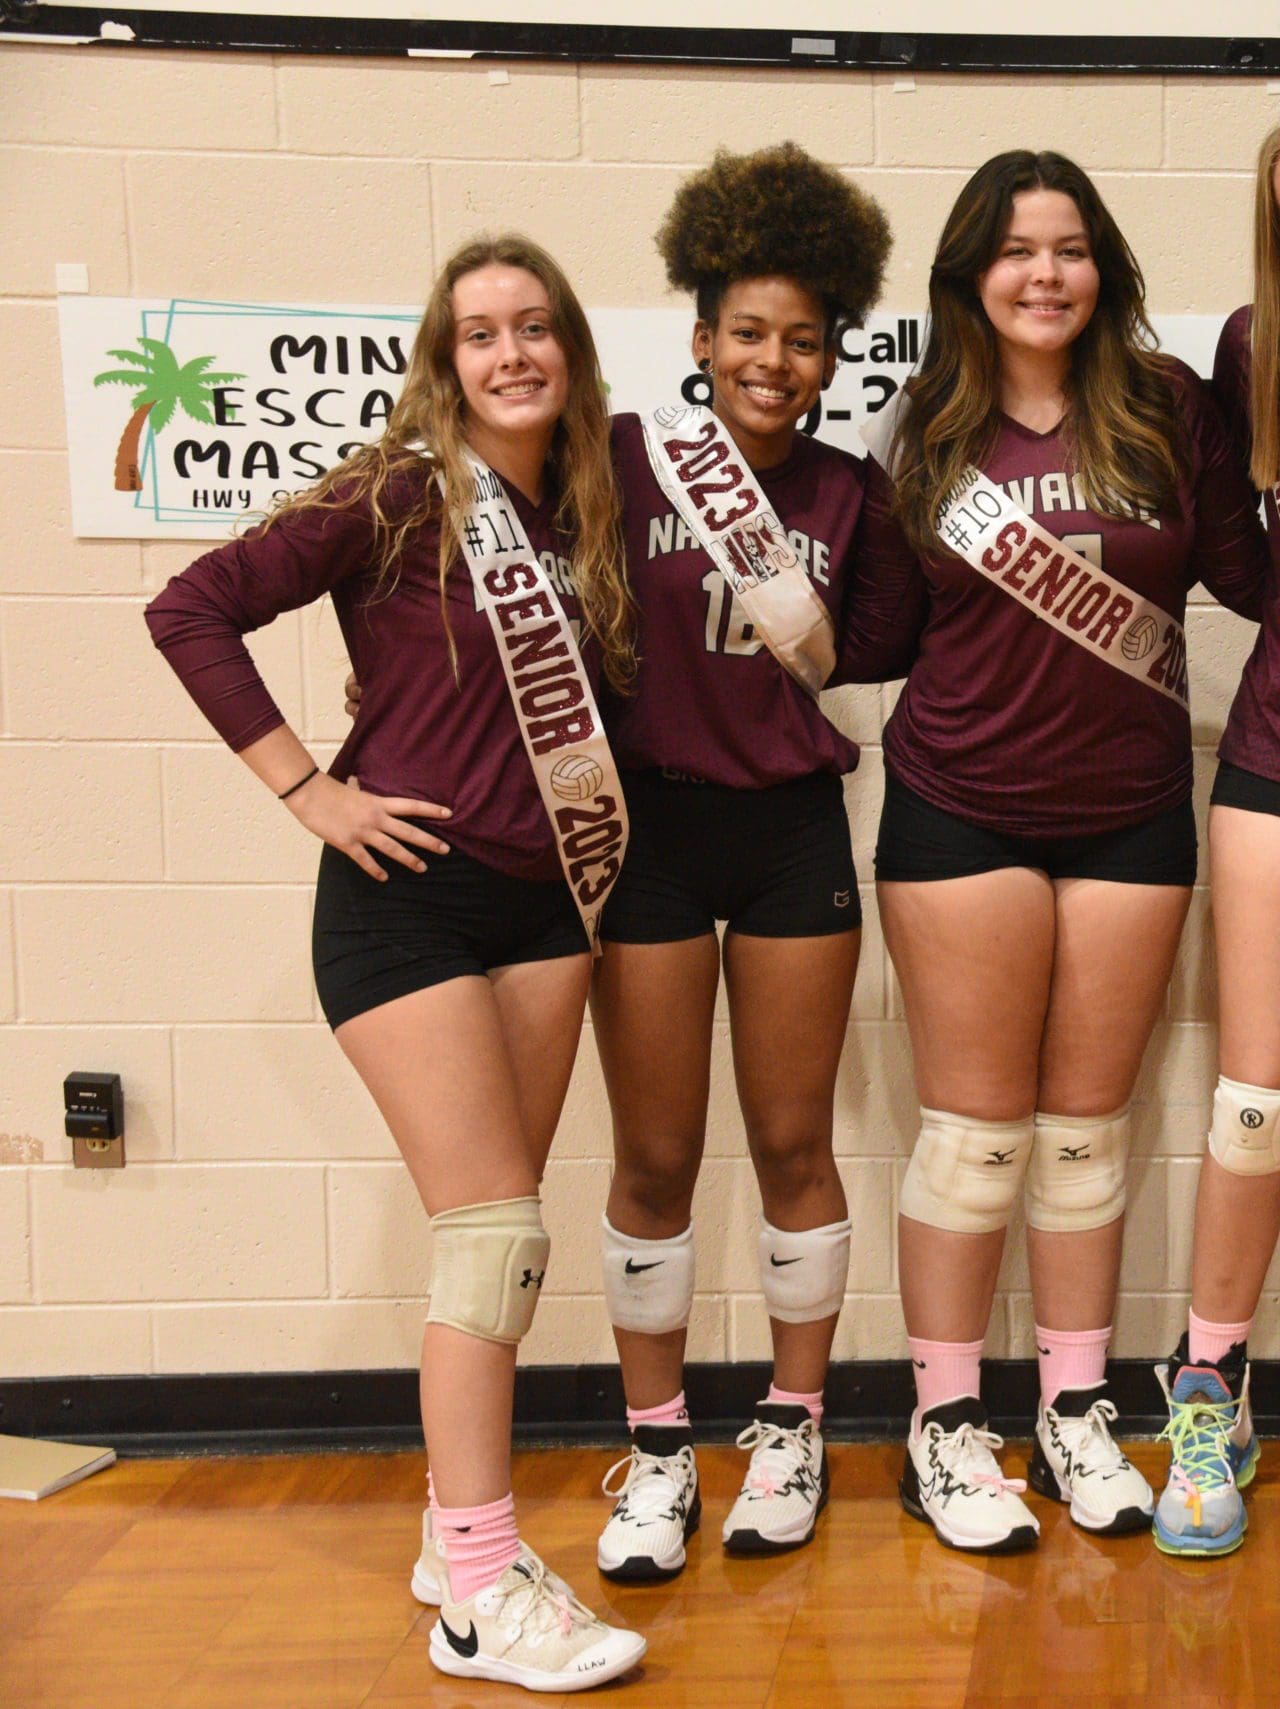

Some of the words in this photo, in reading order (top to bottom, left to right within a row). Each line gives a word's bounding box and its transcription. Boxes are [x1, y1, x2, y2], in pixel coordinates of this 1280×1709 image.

[838, 319, 919, 363] Call
[663, 421, 759, 532] 2023
[945, 490, 1002, 551] #10
[463, 509, 525, 557] #11
[981, 520, 1134, 650] SENIOR
[482, 562, 596, 757] SENIOR
[555, 795, 625, 907] 2023
